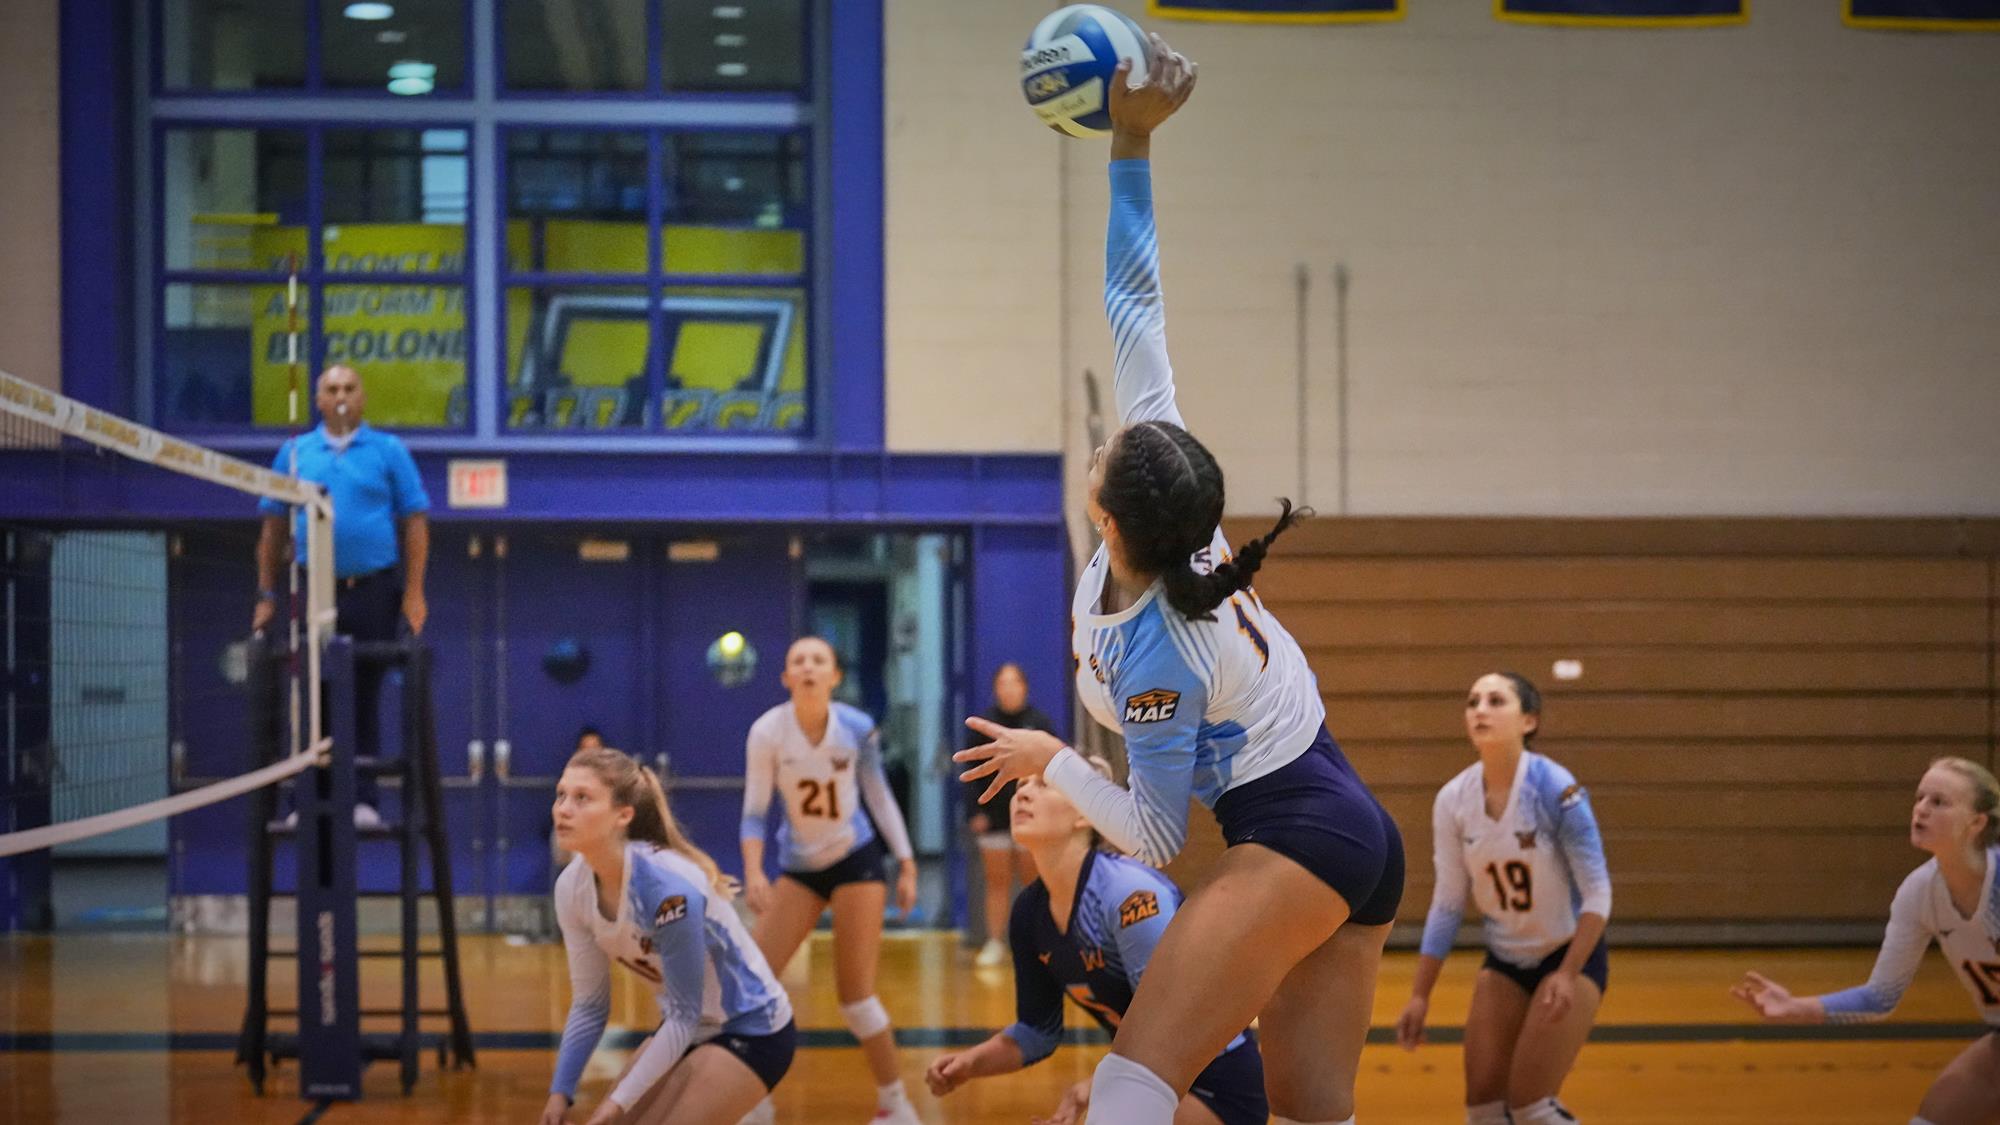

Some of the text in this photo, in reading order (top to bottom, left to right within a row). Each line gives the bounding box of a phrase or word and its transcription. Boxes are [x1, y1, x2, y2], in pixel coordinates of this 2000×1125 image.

[323, 329, 467, 364] COLONE
[1124, 701, 1176, 723] MAC
[798, 779, 839, 821] 21
[1486, 860, 1532, 912] 19
[655, 903, 687, 928] MAC
[1121, 902, 1159, 928] MAC
